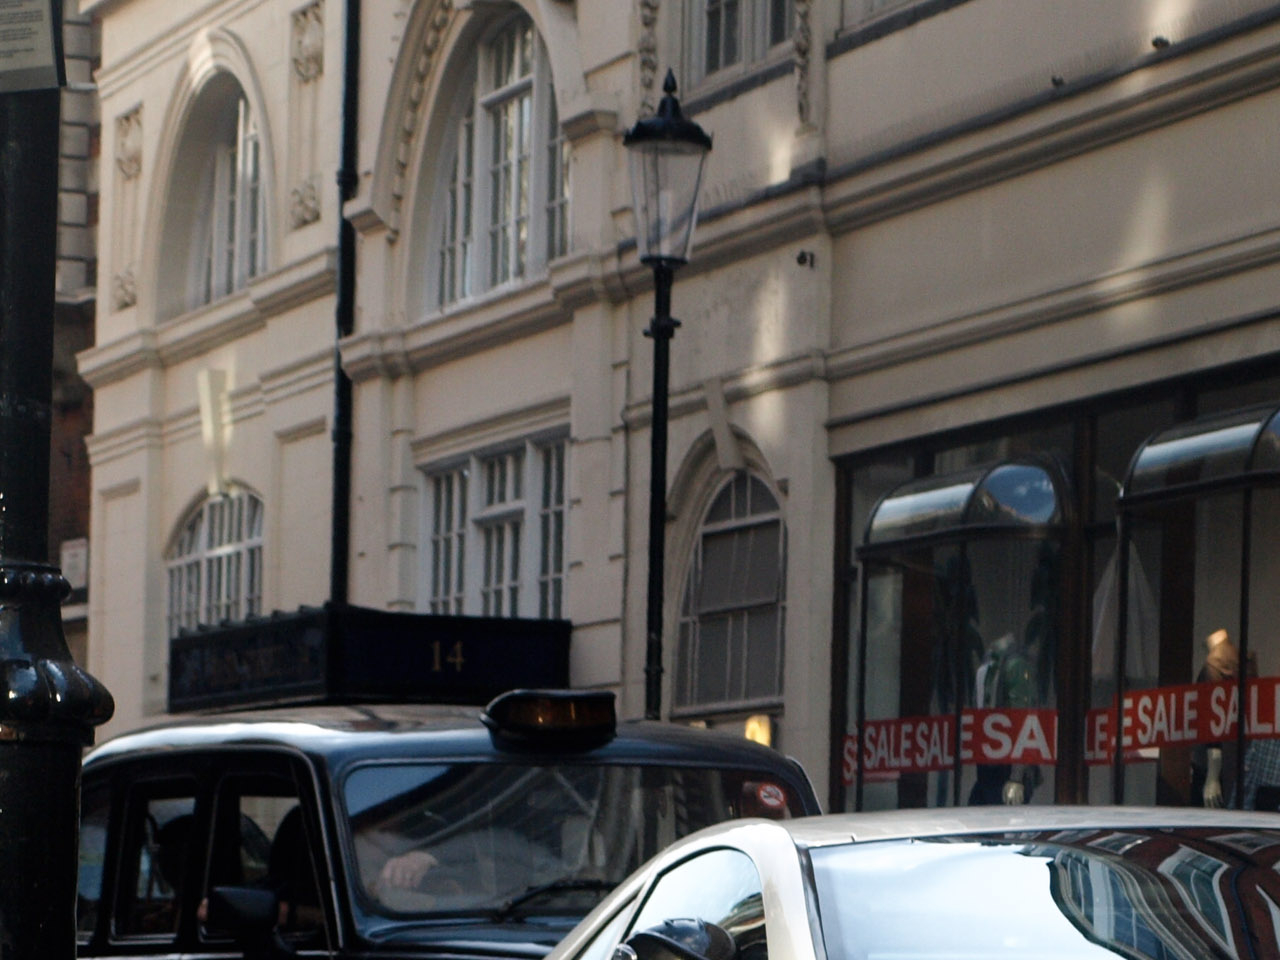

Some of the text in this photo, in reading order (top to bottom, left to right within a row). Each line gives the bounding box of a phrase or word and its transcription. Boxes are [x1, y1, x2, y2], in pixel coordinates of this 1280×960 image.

[429, 640, 465, 672] 14
[863, 723, 912, 769] SALE
[915, 715, 974, 767] SALE
[1137, 691, 1198, 745] SALE
